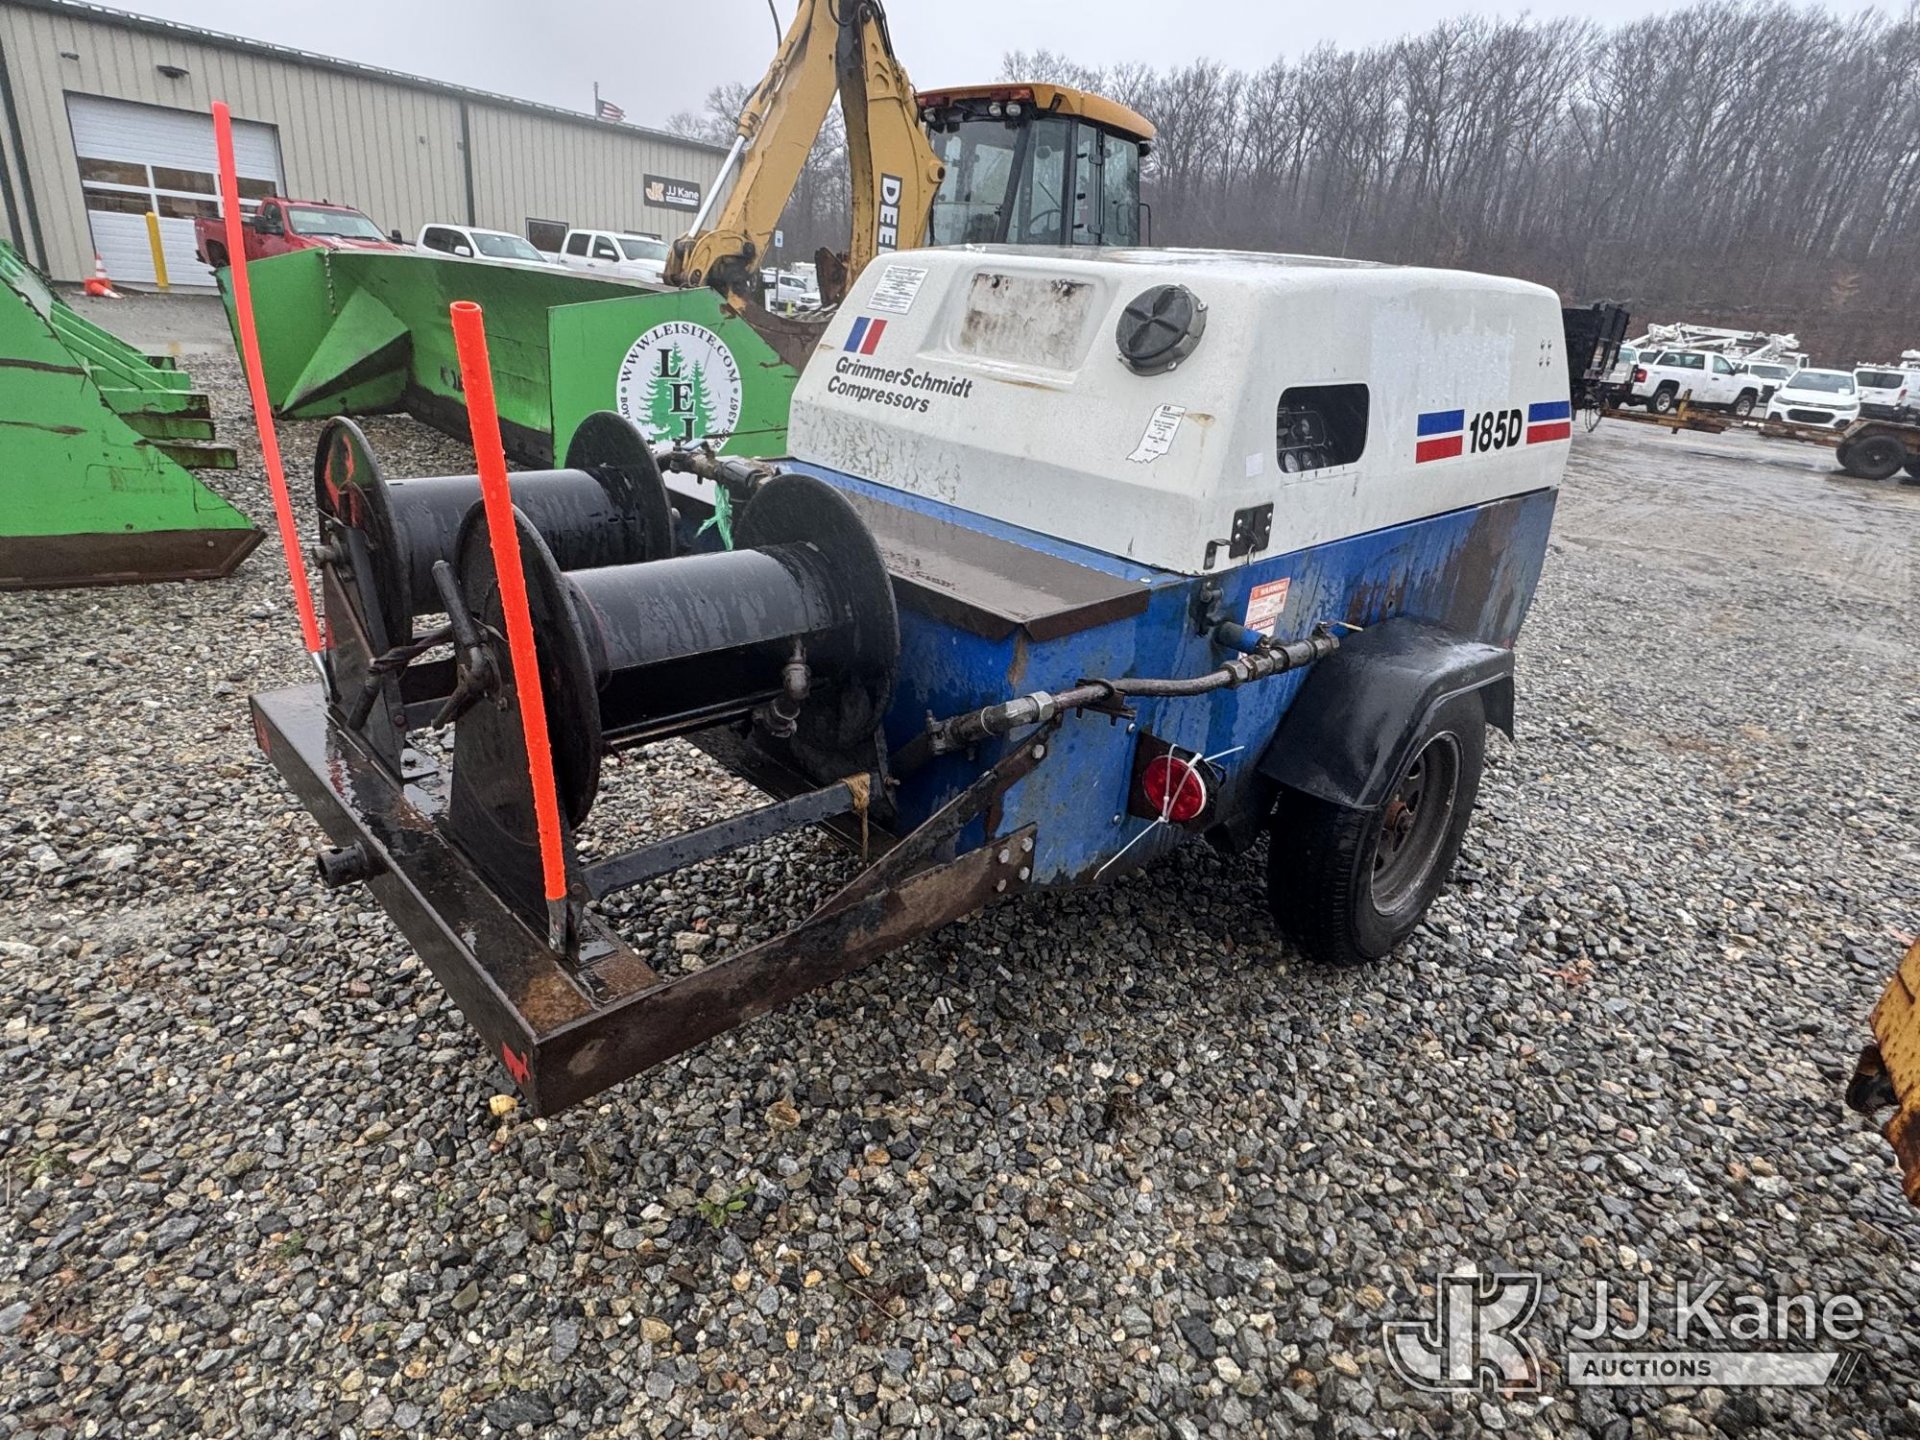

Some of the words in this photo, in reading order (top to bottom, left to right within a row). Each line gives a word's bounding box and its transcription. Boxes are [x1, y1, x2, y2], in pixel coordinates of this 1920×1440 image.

[666, 185, 676, 196] JJ
[677, 187, 699, 200] Kane
[877, 174, 902, 255] DEE
[620, 323, 739, 383] WWW.LEISITE.COM
[827, 376, 930, 413] Compressors
[835, 356, 973, 399] GrimmerSchmidt
[1469, 408, 1523, 454] 185D
